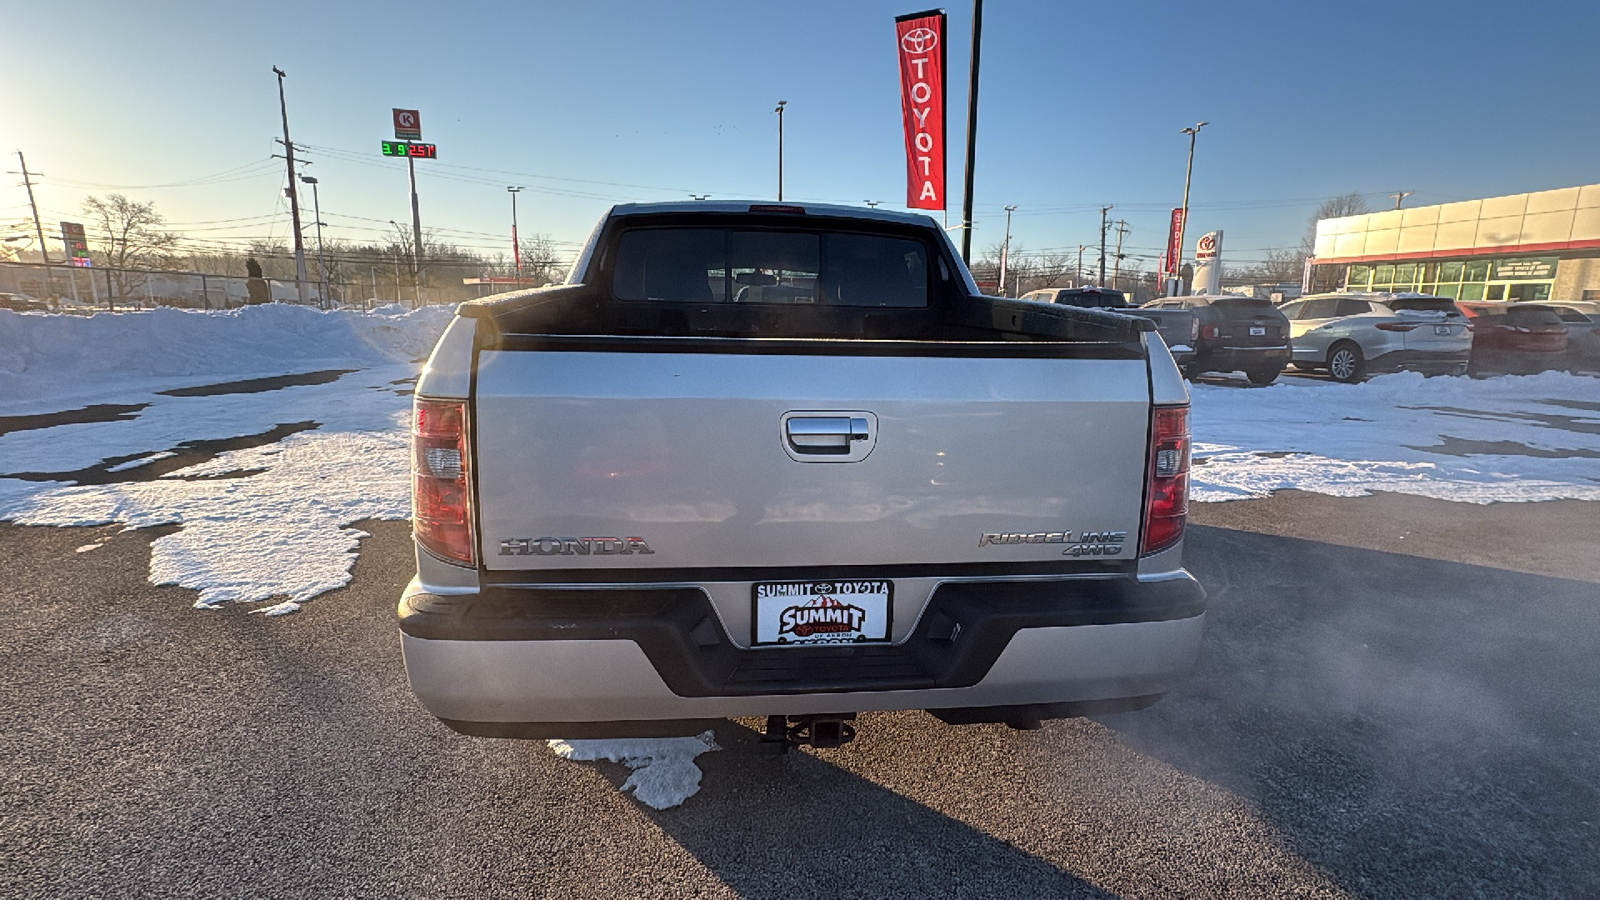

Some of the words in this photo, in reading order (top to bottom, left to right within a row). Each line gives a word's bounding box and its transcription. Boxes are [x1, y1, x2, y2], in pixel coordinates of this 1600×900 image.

[402, 114, 414, 126] K
[911, 58, 937, 201] TOYOTA
[498, 536, 655, 556] HONDA
[978, 530, 1127, 547] RIDGELINE
[1062, 544, 1122, 557] 4WD
[757, 584, 813, 598] SUMMIT
[835, 582, 889, 594] TOYOTA
[782, 607, 863, 632] SUMMIT
[814, 624, 850, 633] TOYOTA
